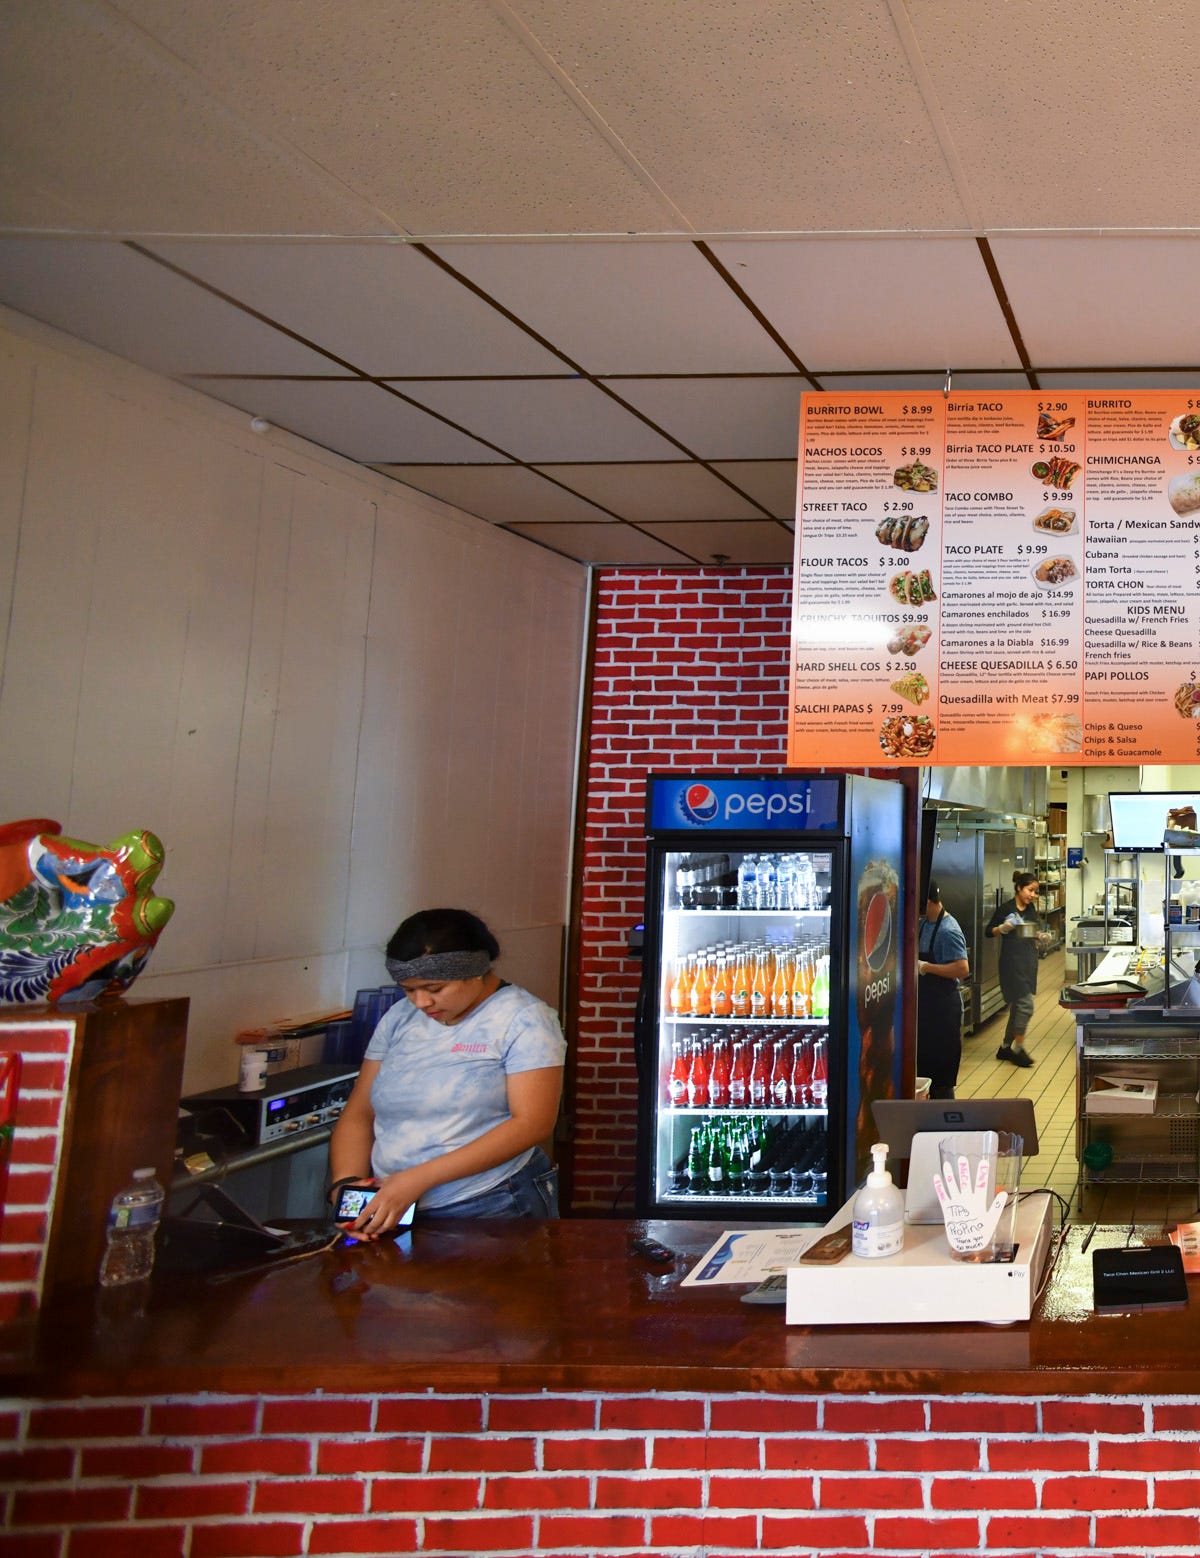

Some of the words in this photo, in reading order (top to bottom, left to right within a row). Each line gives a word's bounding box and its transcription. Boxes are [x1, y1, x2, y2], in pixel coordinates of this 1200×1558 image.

[1088, 400, 1132, 408] BURRITO
[807, 406, 851, 415] BURRITO
[854, 406, 884, 414] BOWL
[806, 448, 847, 456] NACHOS
[850, 448, 882, 456] LOCOS
[946, 444, 973, 453] Birria
[976, 444, 1002, 453] TACO
[1005, 444, 1034, 453] PLATE
[1086, 456, 1161, 464] CHIMICHANGA
[803, 503, 839, 512] STREET
[841, 502, 868, 511] TACO
[1088, 520, 1114, 529] Torta
[1125, 520, 1167, 528] Mexican
[1086, 535, 1127, 543] Hawaiian
[1086, 550, 1119, 558] Cubana
[801, 558, 834, 566] FLOUR
[836, 558, 868, 566] TACOS
[996, 592, 1017, 600] mojo
[1030, 590, 1043, 600] ajo
[1128, 606, 1150, 615] KIDS
[1153, 606, 1185, 614] MENU
[997, 638, 1005, 646] la
[1007, 638, 1034, 646] Diabla
[1085, 640, 1126, 649] Quesadilla
[1128, 640, 1140, 649] w/
[798, 662, 826, 671] HARD
[828, 662, 858, 671] SHELL
[860, 662, 880, 671] COS
[940, 661, 978, 670] CHEESE
[980, 660, 1044, 670] QUESADILLA
[1085, 672, 1107, 680] PAPI
[1110, 672, 1149, 680] POLLOS
[940, 694, 993, 704] Quesadilla
[996, 694, 1018, 703] with
[1022, 694, 1048, 703] Meat
[794, 704, 830, 714] SALCHI
[832, 704, 864, 714] PAPAS
[1084, 749, 1107, 758] Chips
[1116, 748, 1162, 756] Guacamole
[725, 788, 812, 820] pepsi
[864, 972, 890, 1008] pepsi
